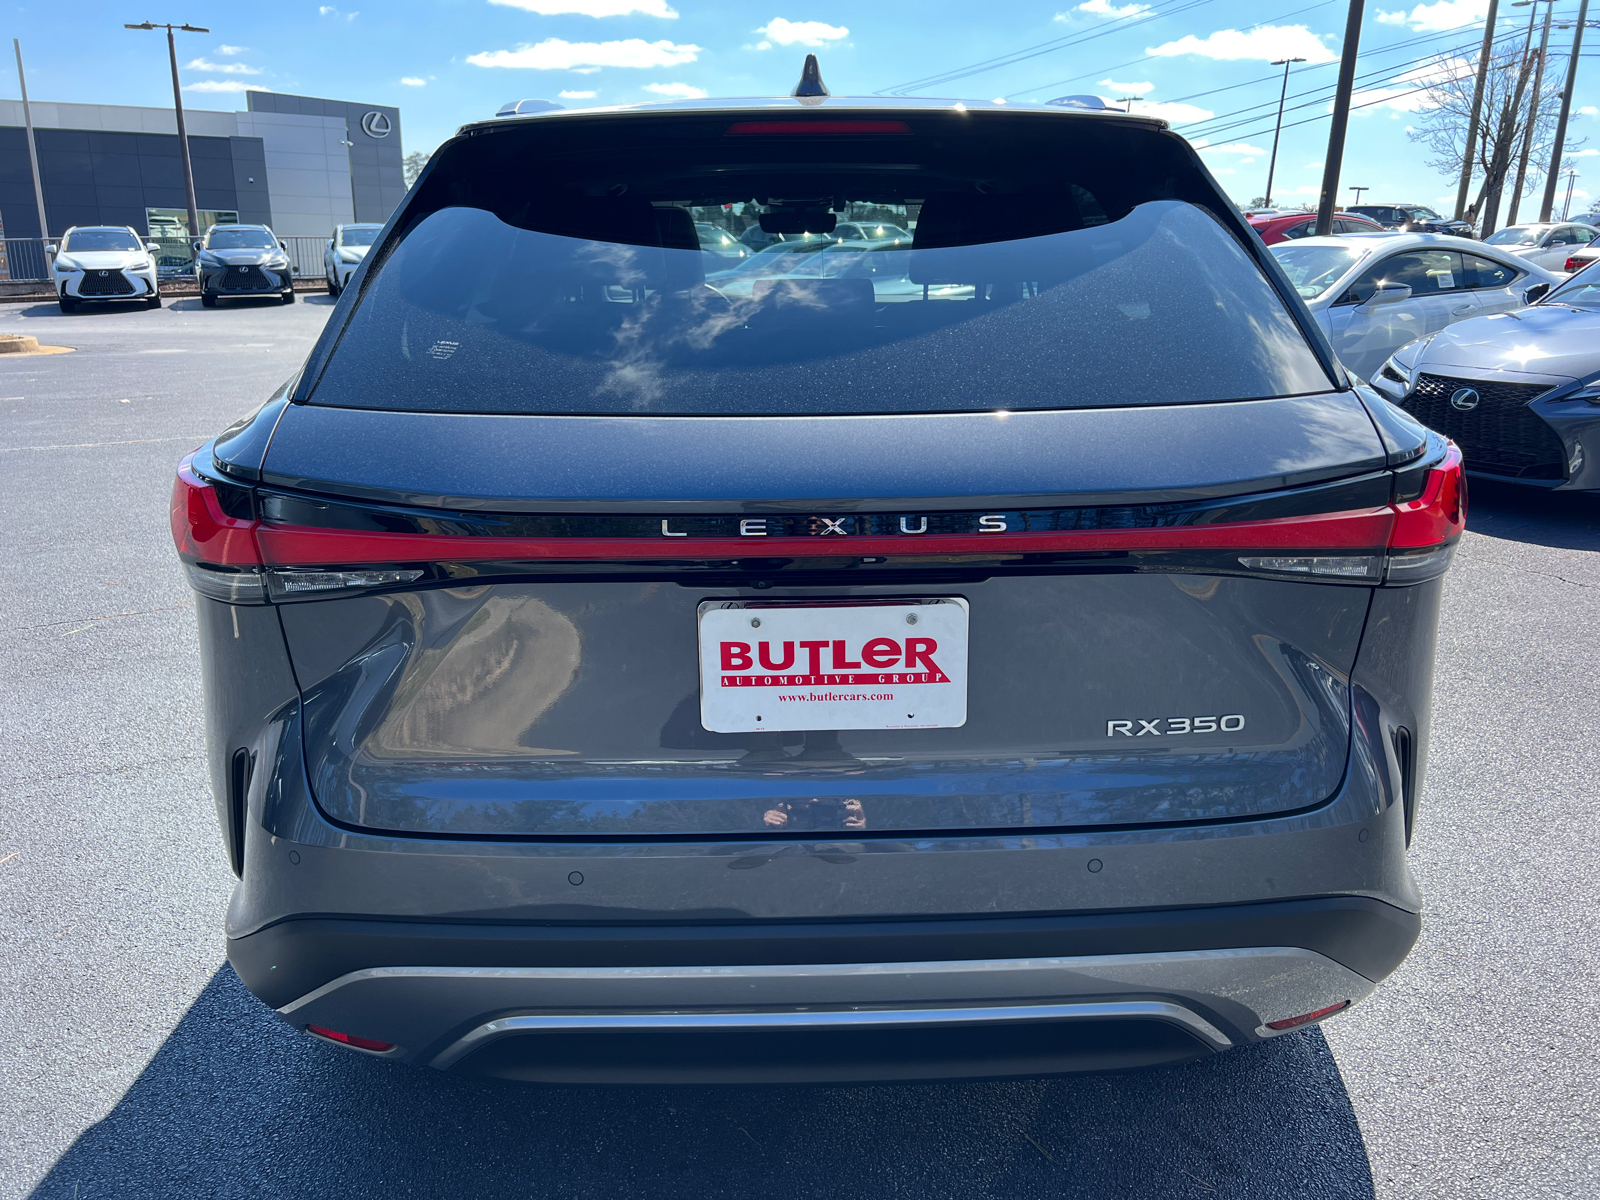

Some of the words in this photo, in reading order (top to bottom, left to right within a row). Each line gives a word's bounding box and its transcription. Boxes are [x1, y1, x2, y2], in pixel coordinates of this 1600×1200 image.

[661, 514, 1008, 537] LEXUS
[722, 674, 855, 686] AUTOMOTIVE
[878, 672, 943, 683] GROUP
[778, 692, 894, 703] www.butlercars.com
